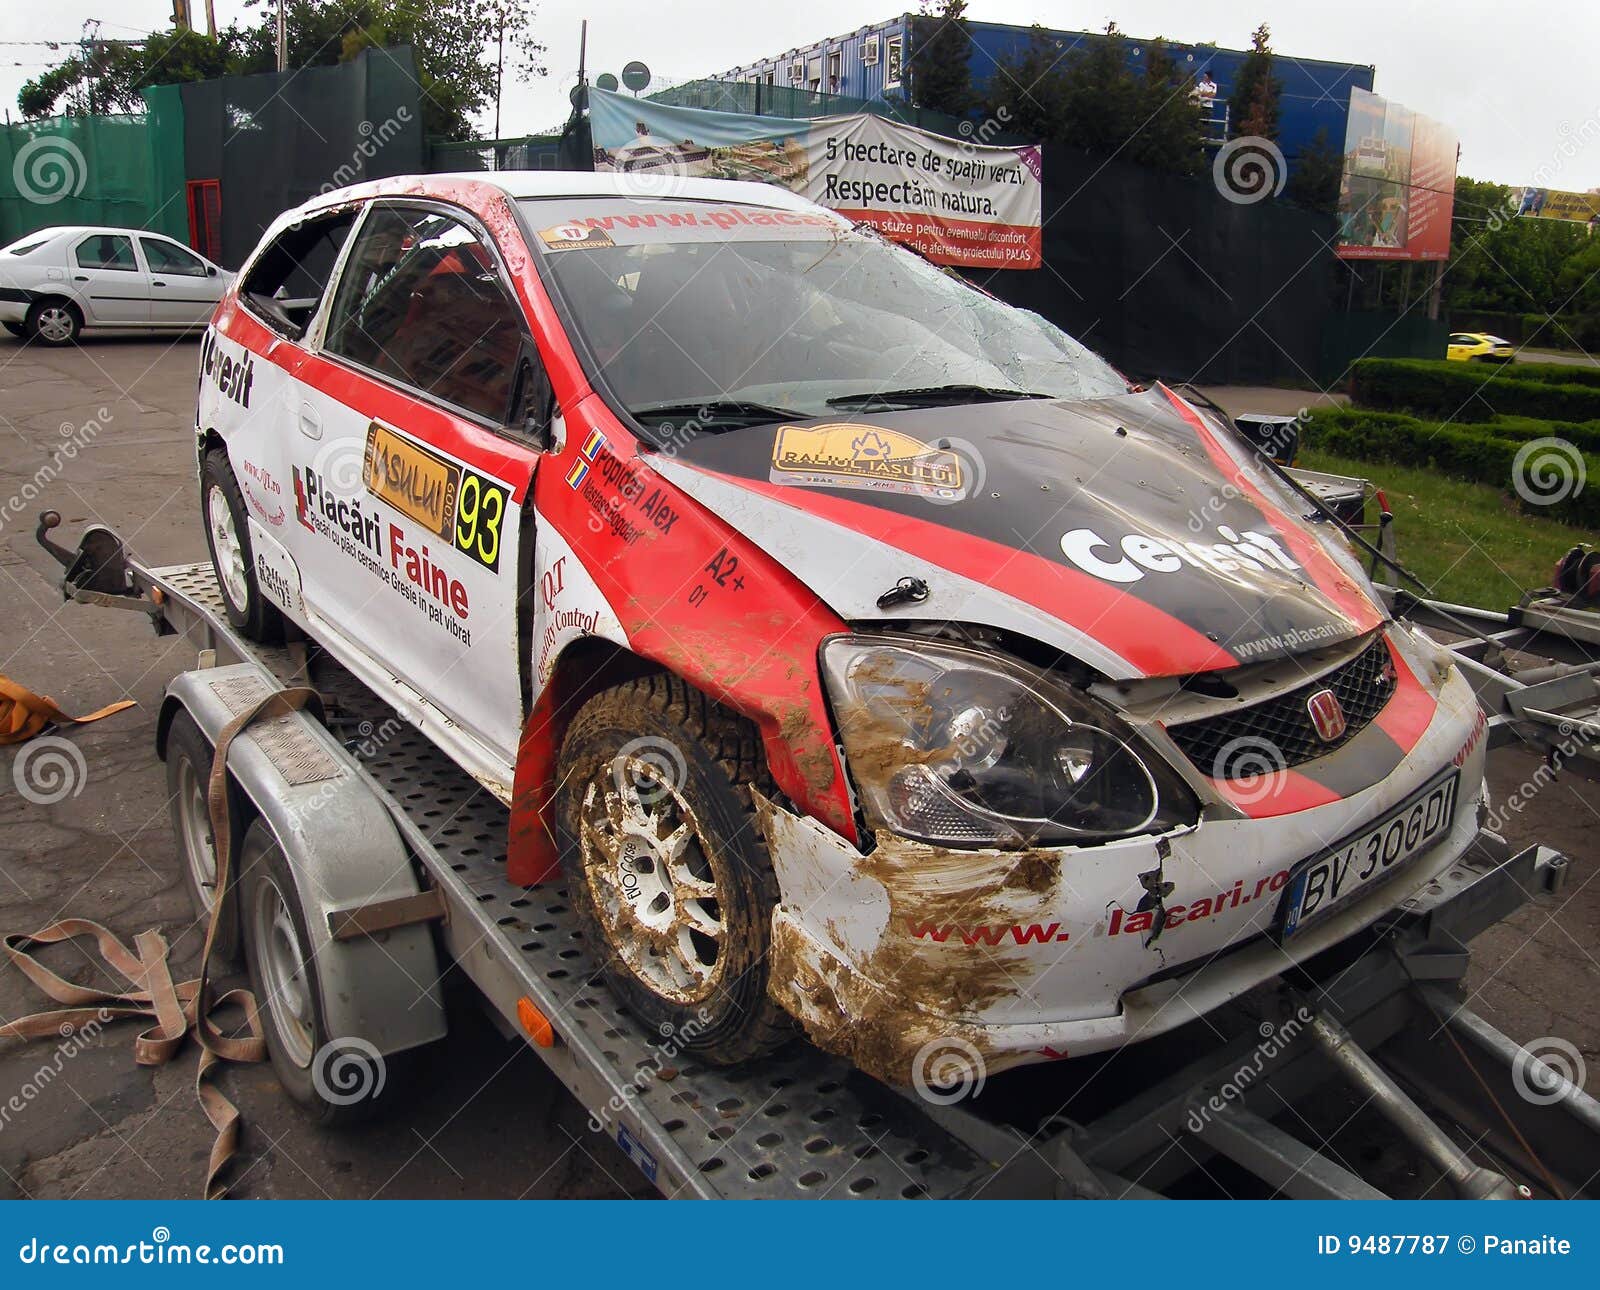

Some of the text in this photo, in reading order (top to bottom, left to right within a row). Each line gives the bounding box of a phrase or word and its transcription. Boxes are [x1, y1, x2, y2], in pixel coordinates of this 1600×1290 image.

[825, 137, 837, 161] 5
[844, 137, 917, 167] hectare
[922, 150, 941, 172] de
[826, 174, 998, 217] Respectăm natura.
[561, 229, 582, 238] 17
[882, 218, 914, 234] scuze
[916, 222, 945, 237] pentru
[784, 451, 863, 469] RALIUL
[869, 461, 953, 483] IASULUI
[443, 482, 456, 528] 2009
[457, 475, 504, 565] 93
[640, 488, 679, 536] Alex
[305, 465, 382, 557] Placări
[389, 522, 469, 620] Faine
[331, 530, 340, 545] cu
[357, 550, 390, 582] ceramice
[391, 572, 418, 605] Gresie
[418, 592, 427, 613] in
[428, 602, 443, 627] pat
[445, 615, 472, 648] vibrat
[704, 547, 745, 592] A2+
[555, 607, 600, 634] Control
[1300, 847, 1354, 919] BV
